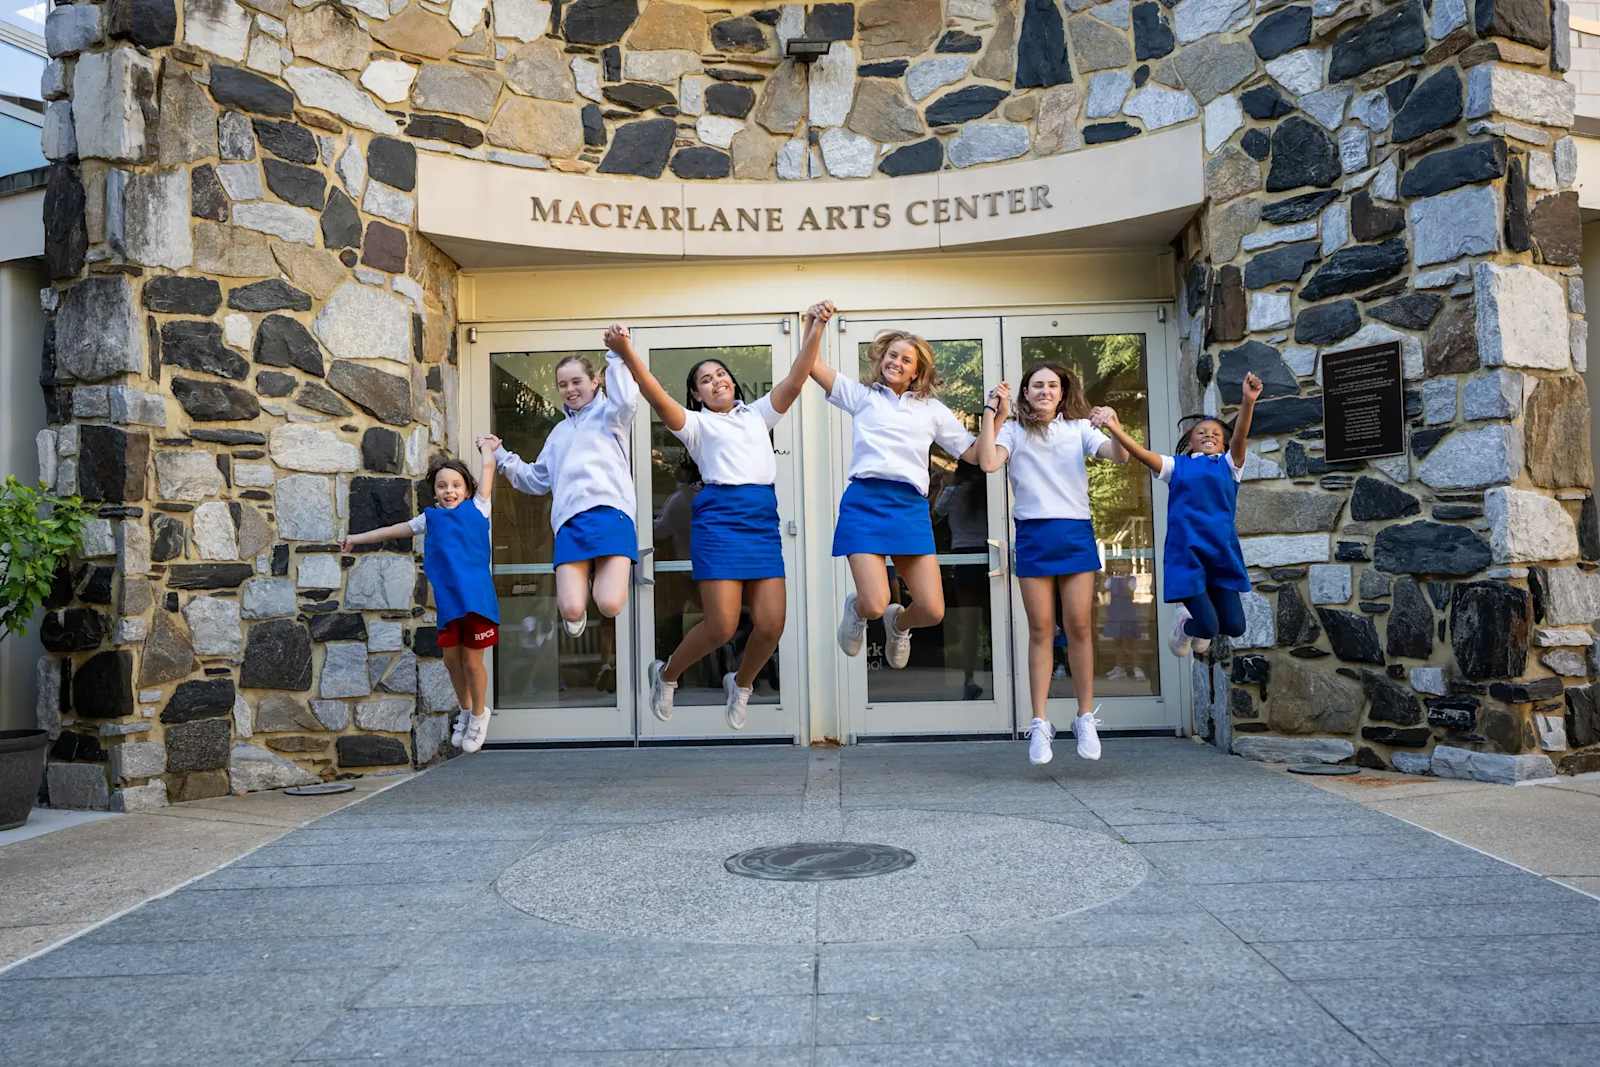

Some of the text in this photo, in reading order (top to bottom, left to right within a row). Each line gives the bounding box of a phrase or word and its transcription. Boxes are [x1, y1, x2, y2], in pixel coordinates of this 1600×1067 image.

[531, 184, 1054, 232] MACFARLANE ARTS CENTER
[474, 628, 495, 641] RPCS
